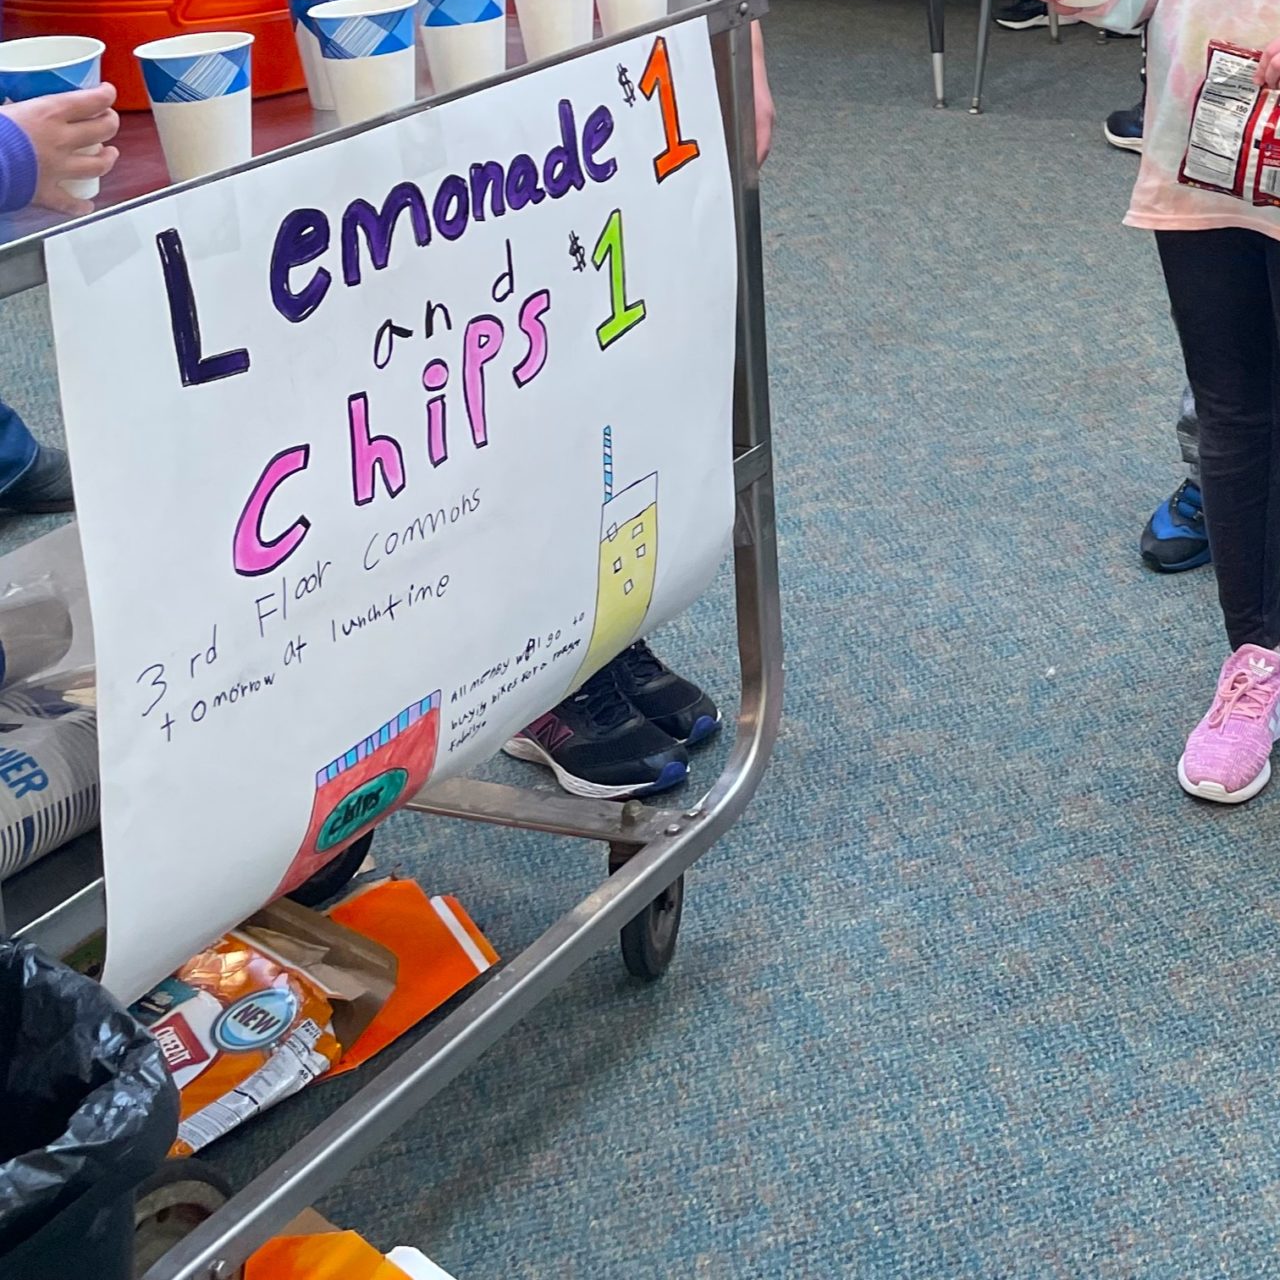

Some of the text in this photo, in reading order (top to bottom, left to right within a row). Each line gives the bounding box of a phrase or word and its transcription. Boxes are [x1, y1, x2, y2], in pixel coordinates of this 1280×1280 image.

[1235, 104, 1249, 115] 150
[156, 36, 700, 387] Lemonade $1
[373, 238, 515, 370] and
[568, 209, 646, 351] $1
[255, 561, 332, 637] Floor
[546, 629, 561, 649] go
[161, 574, 450, 742] tomorrow at lunchtime
[232, 1003, 281, 1035] NEW
